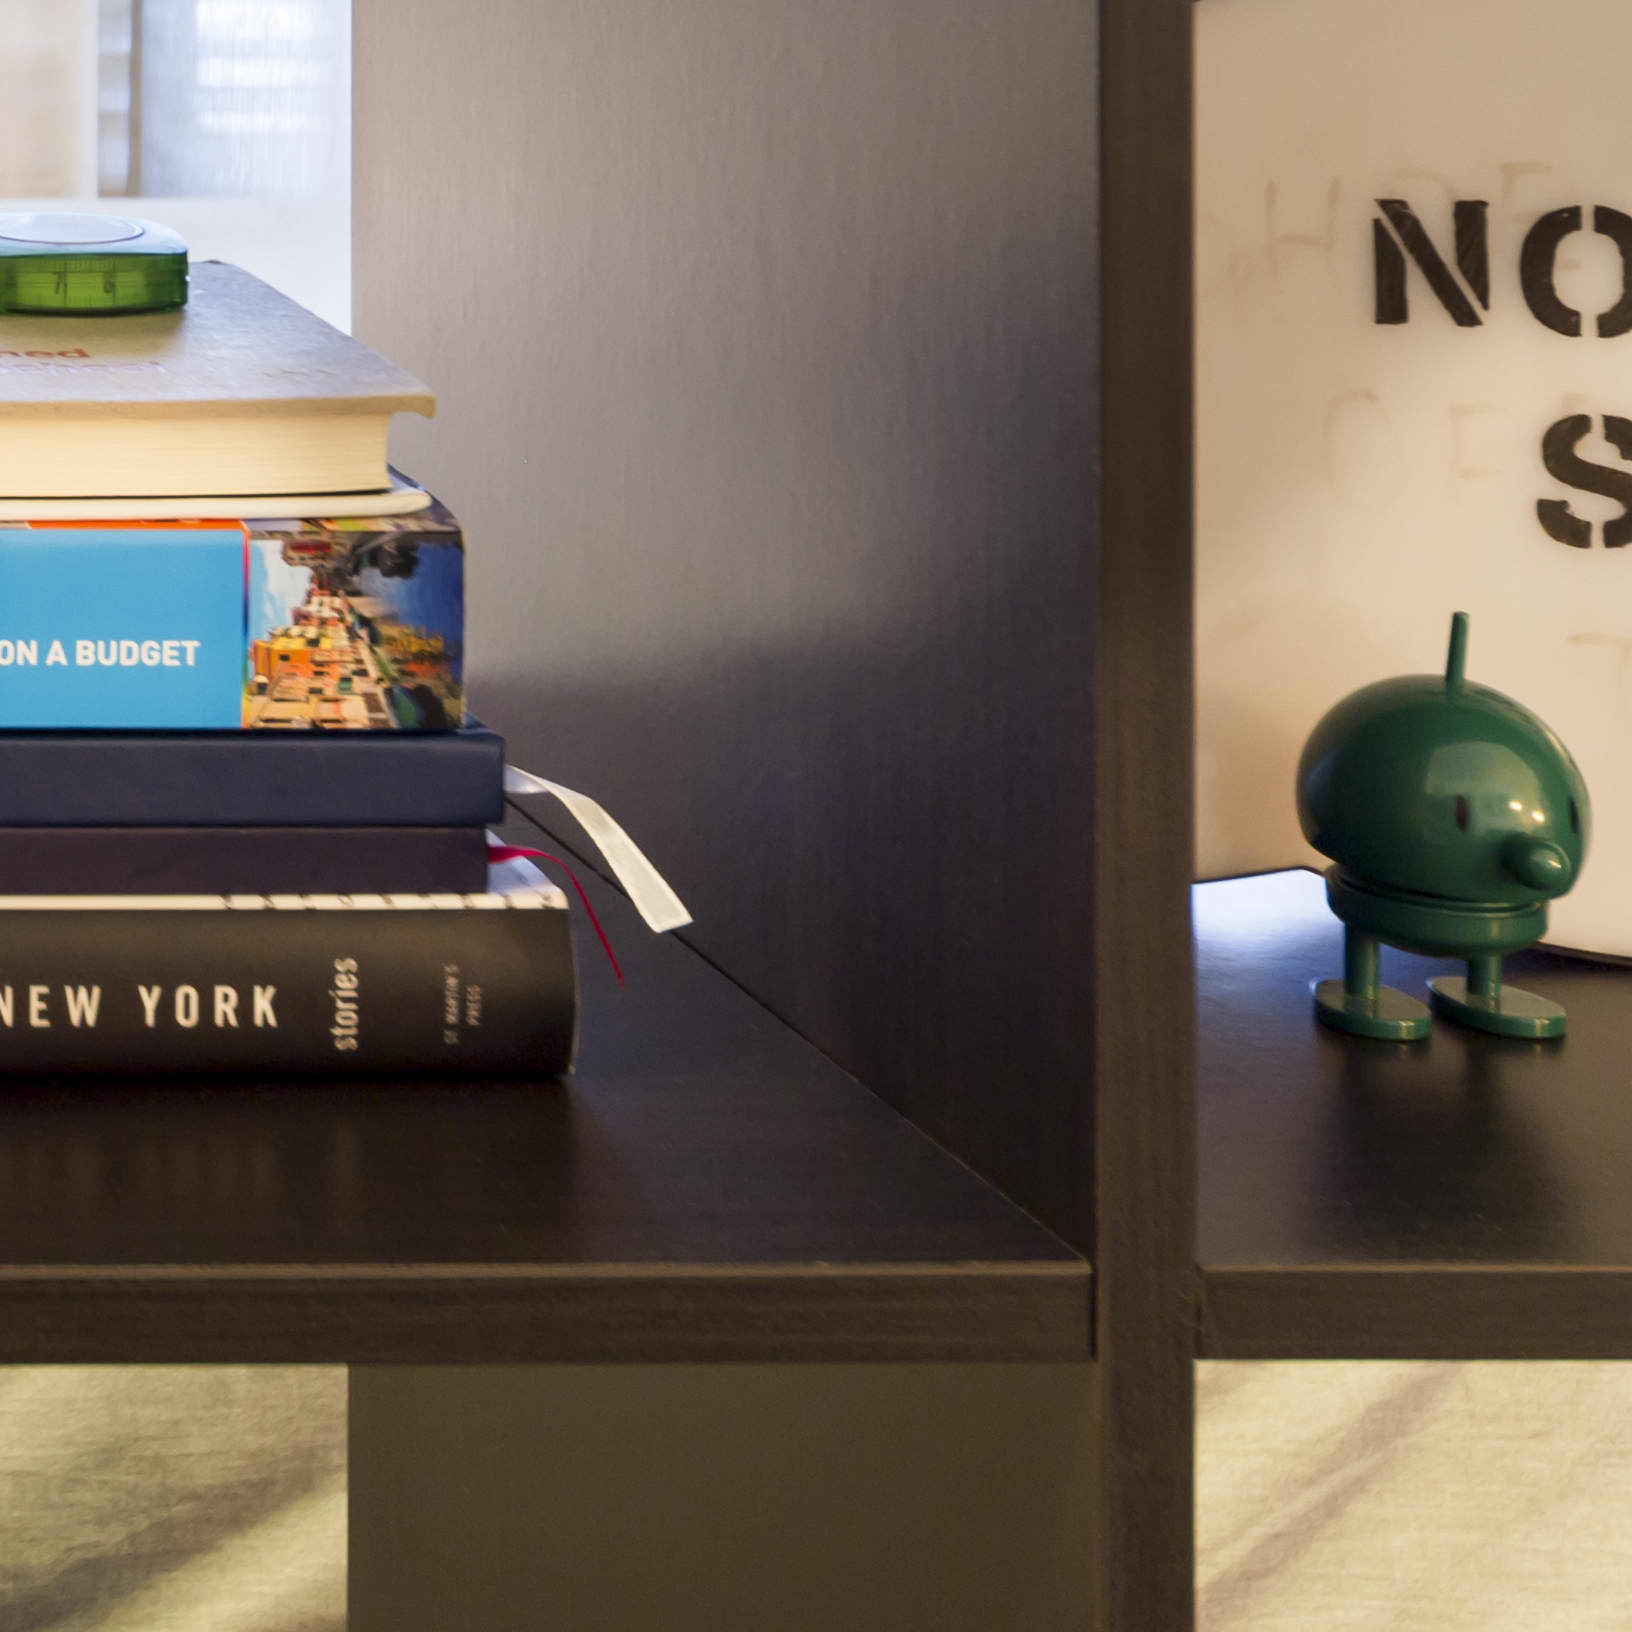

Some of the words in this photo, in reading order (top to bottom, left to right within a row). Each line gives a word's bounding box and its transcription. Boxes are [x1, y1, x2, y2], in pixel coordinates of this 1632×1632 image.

[45, 639, 68, 667] A
[75, 639, 201, 667] BUDGET
[138, 983, 279, 1028] YORK
[332, 956, 360, 1052] stories
